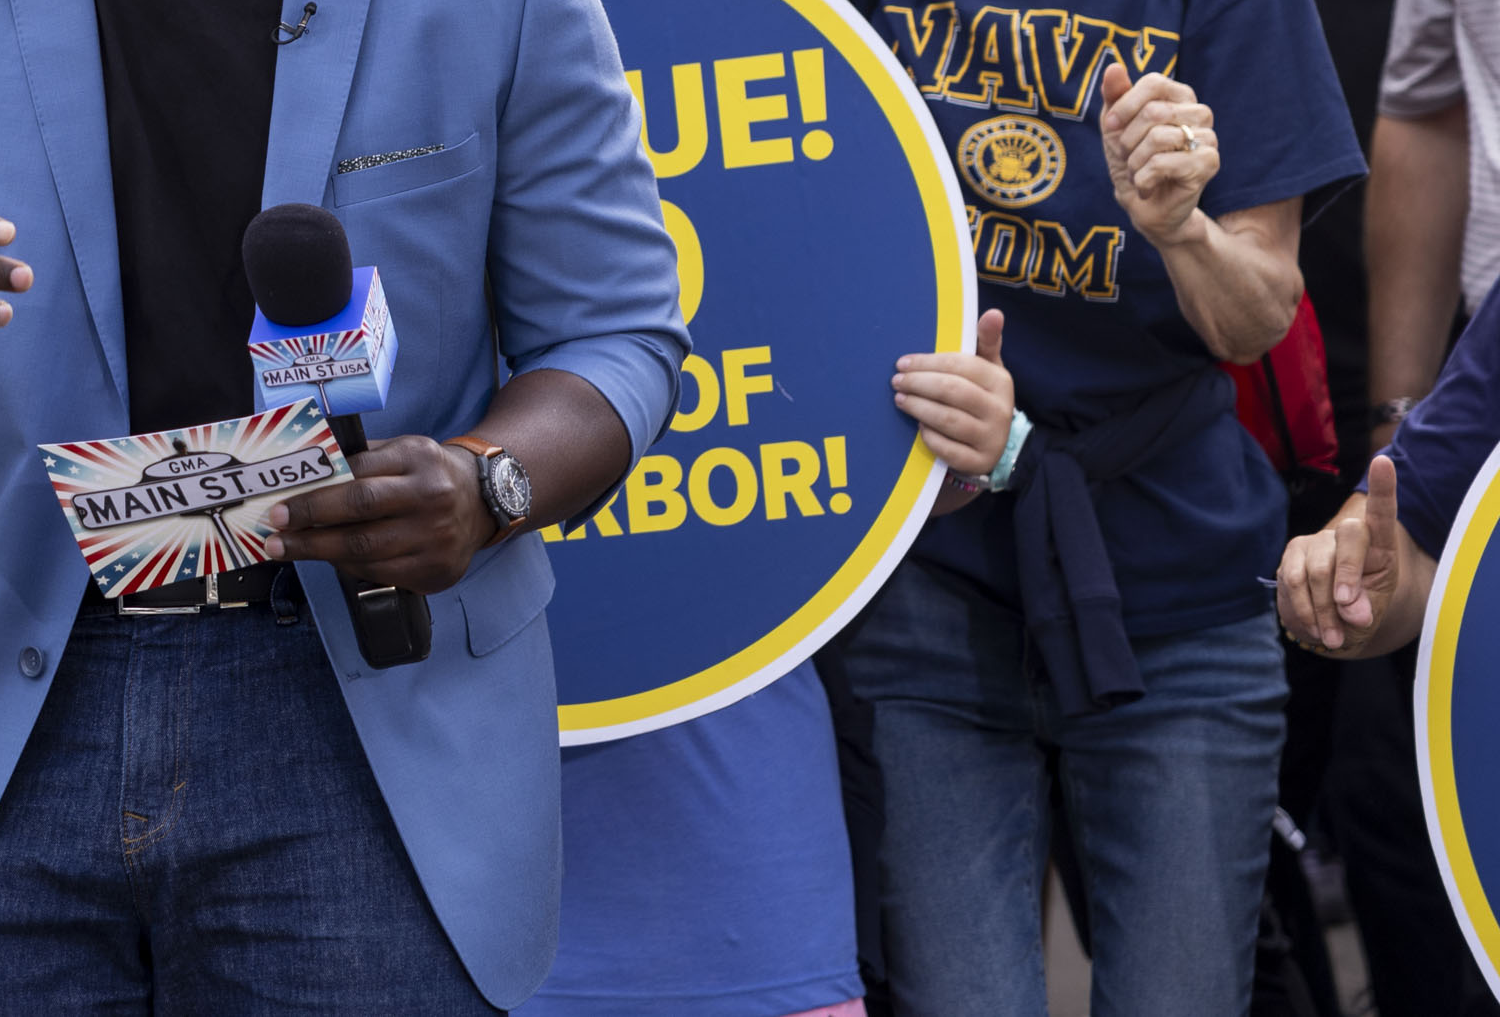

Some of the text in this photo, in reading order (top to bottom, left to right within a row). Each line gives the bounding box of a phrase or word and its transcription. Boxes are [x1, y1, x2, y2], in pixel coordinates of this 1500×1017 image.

[966, 204, 1125, 302] OM
[268, 367, 311, 385] MAIN
[340, 363, 365, 375] USA
[85, 460, 319, 524] MAIN ST. USA
[169, 457, 209, 474] GMA
[539, 435, 852, 543] BOR!
